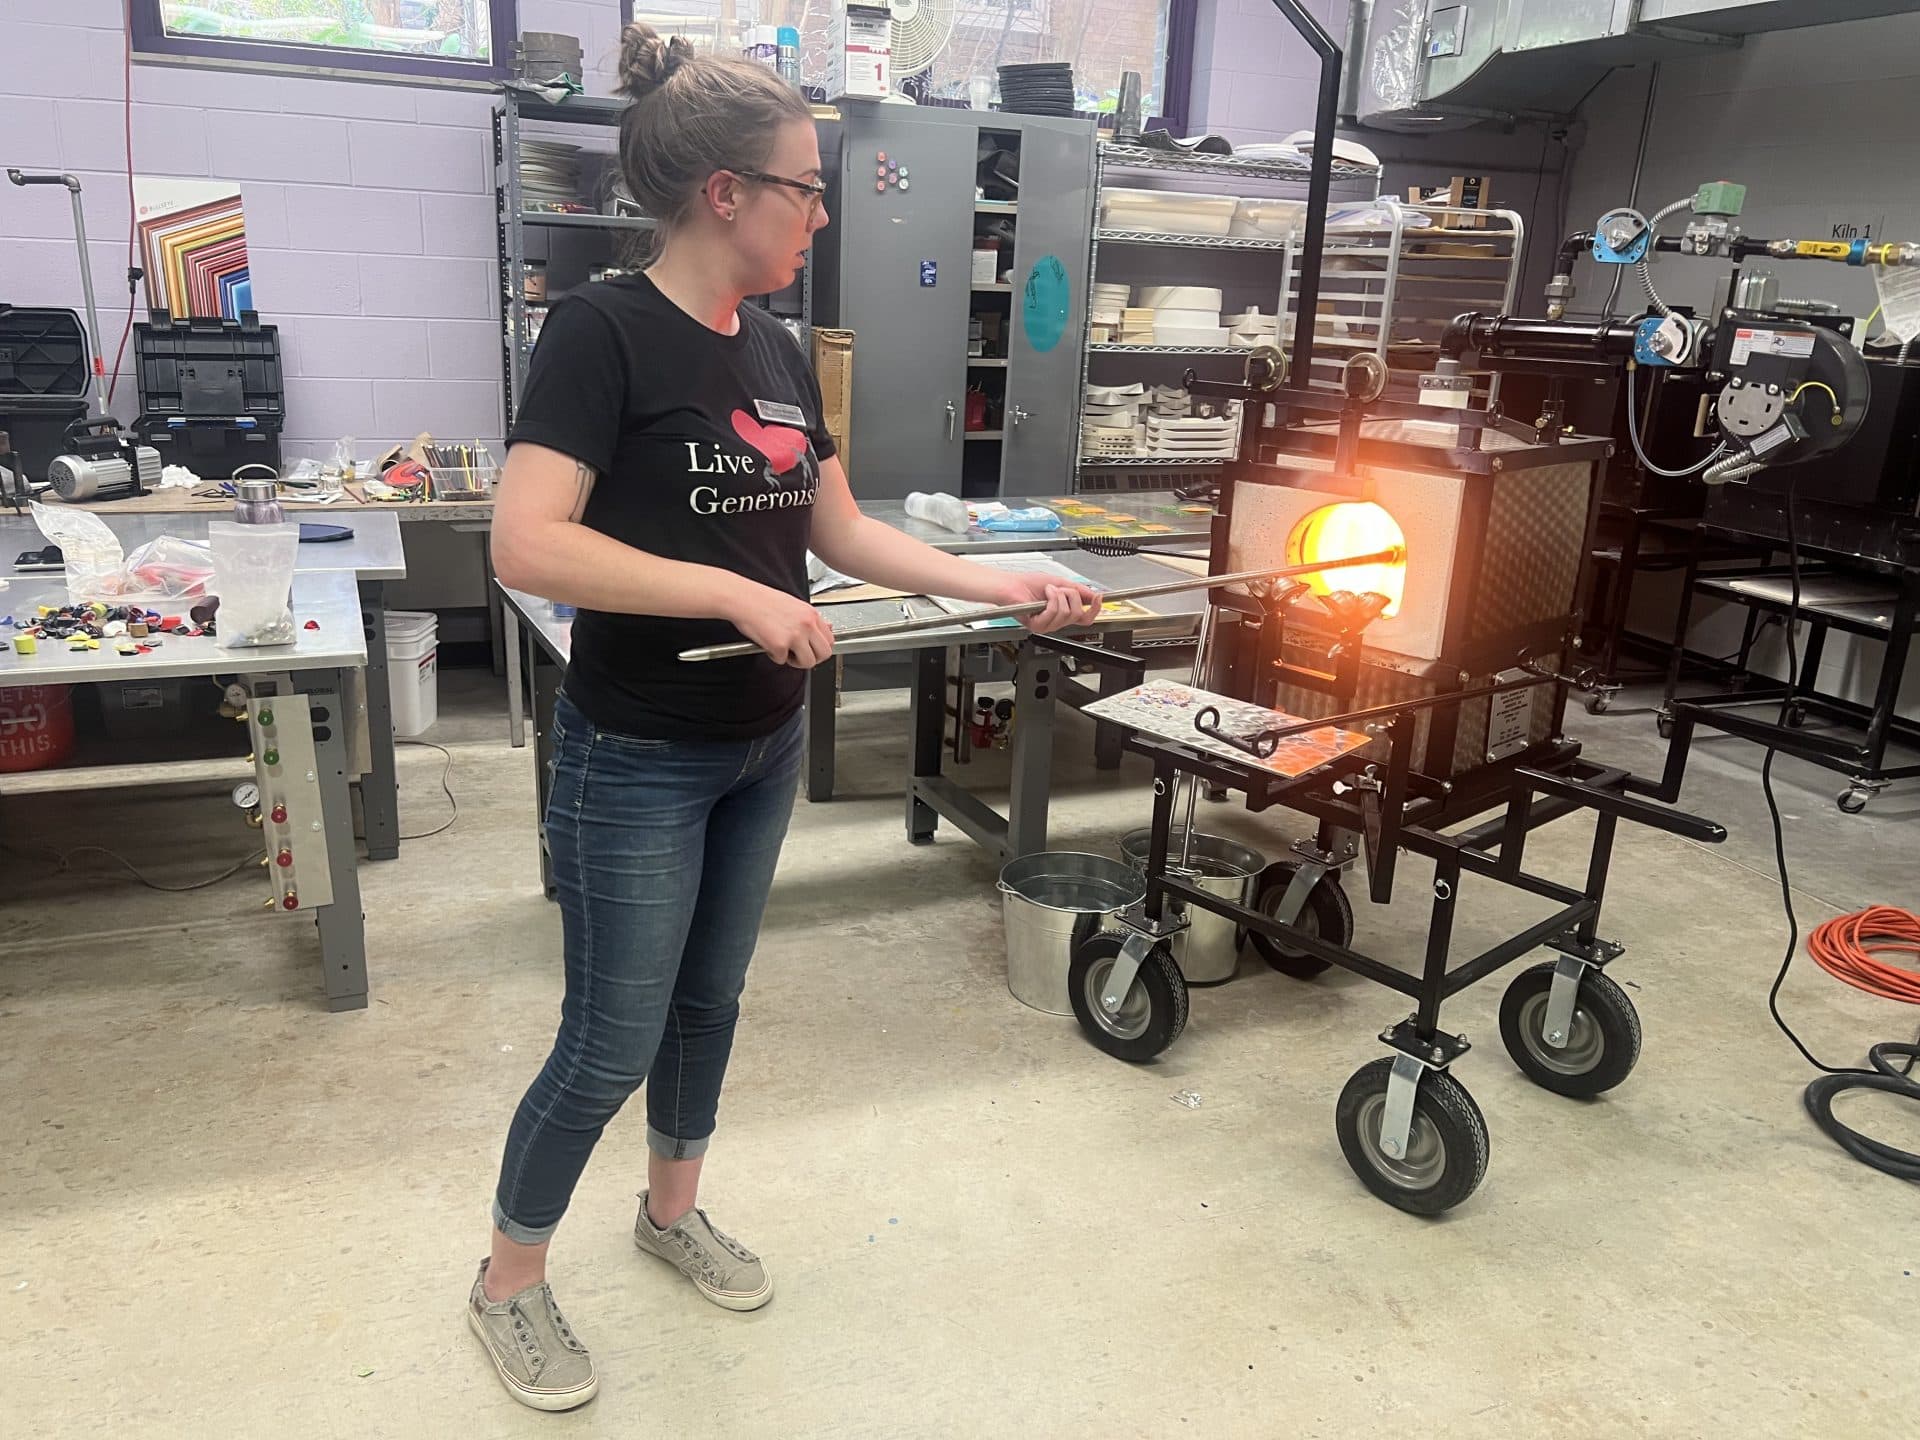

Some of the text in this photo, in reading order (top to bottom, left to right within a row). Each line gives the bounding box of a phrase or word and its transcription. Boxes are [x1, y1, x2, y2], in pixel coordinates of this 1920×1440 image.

[874, 63, 882, 81] 1
[1832, 224, 1870, 239] Kiln 1
[685, 442, 755, 475] Live
[689, 477, 819, 515] Generousl
